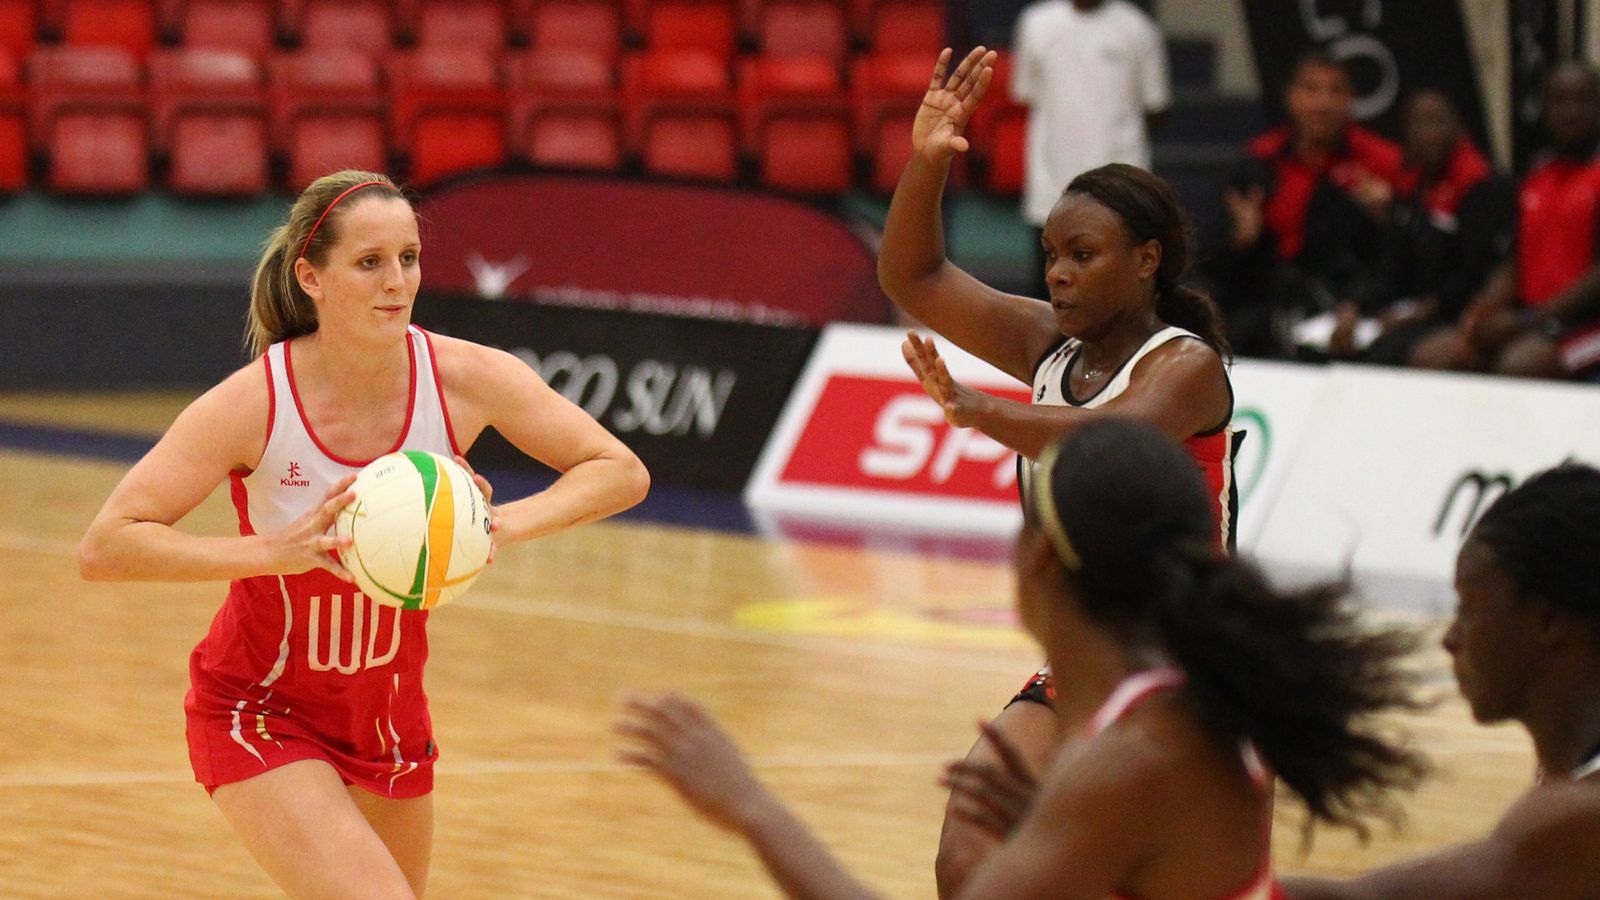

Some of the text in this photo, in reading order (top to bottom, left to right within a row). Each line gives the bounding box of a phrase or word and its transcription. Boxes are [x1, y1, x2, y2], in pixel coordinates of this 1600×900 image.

[614, 359, 737, 439] SUN
[280, 478, 310, 487] KUKRI
[308, 592, 402, 675] WD
